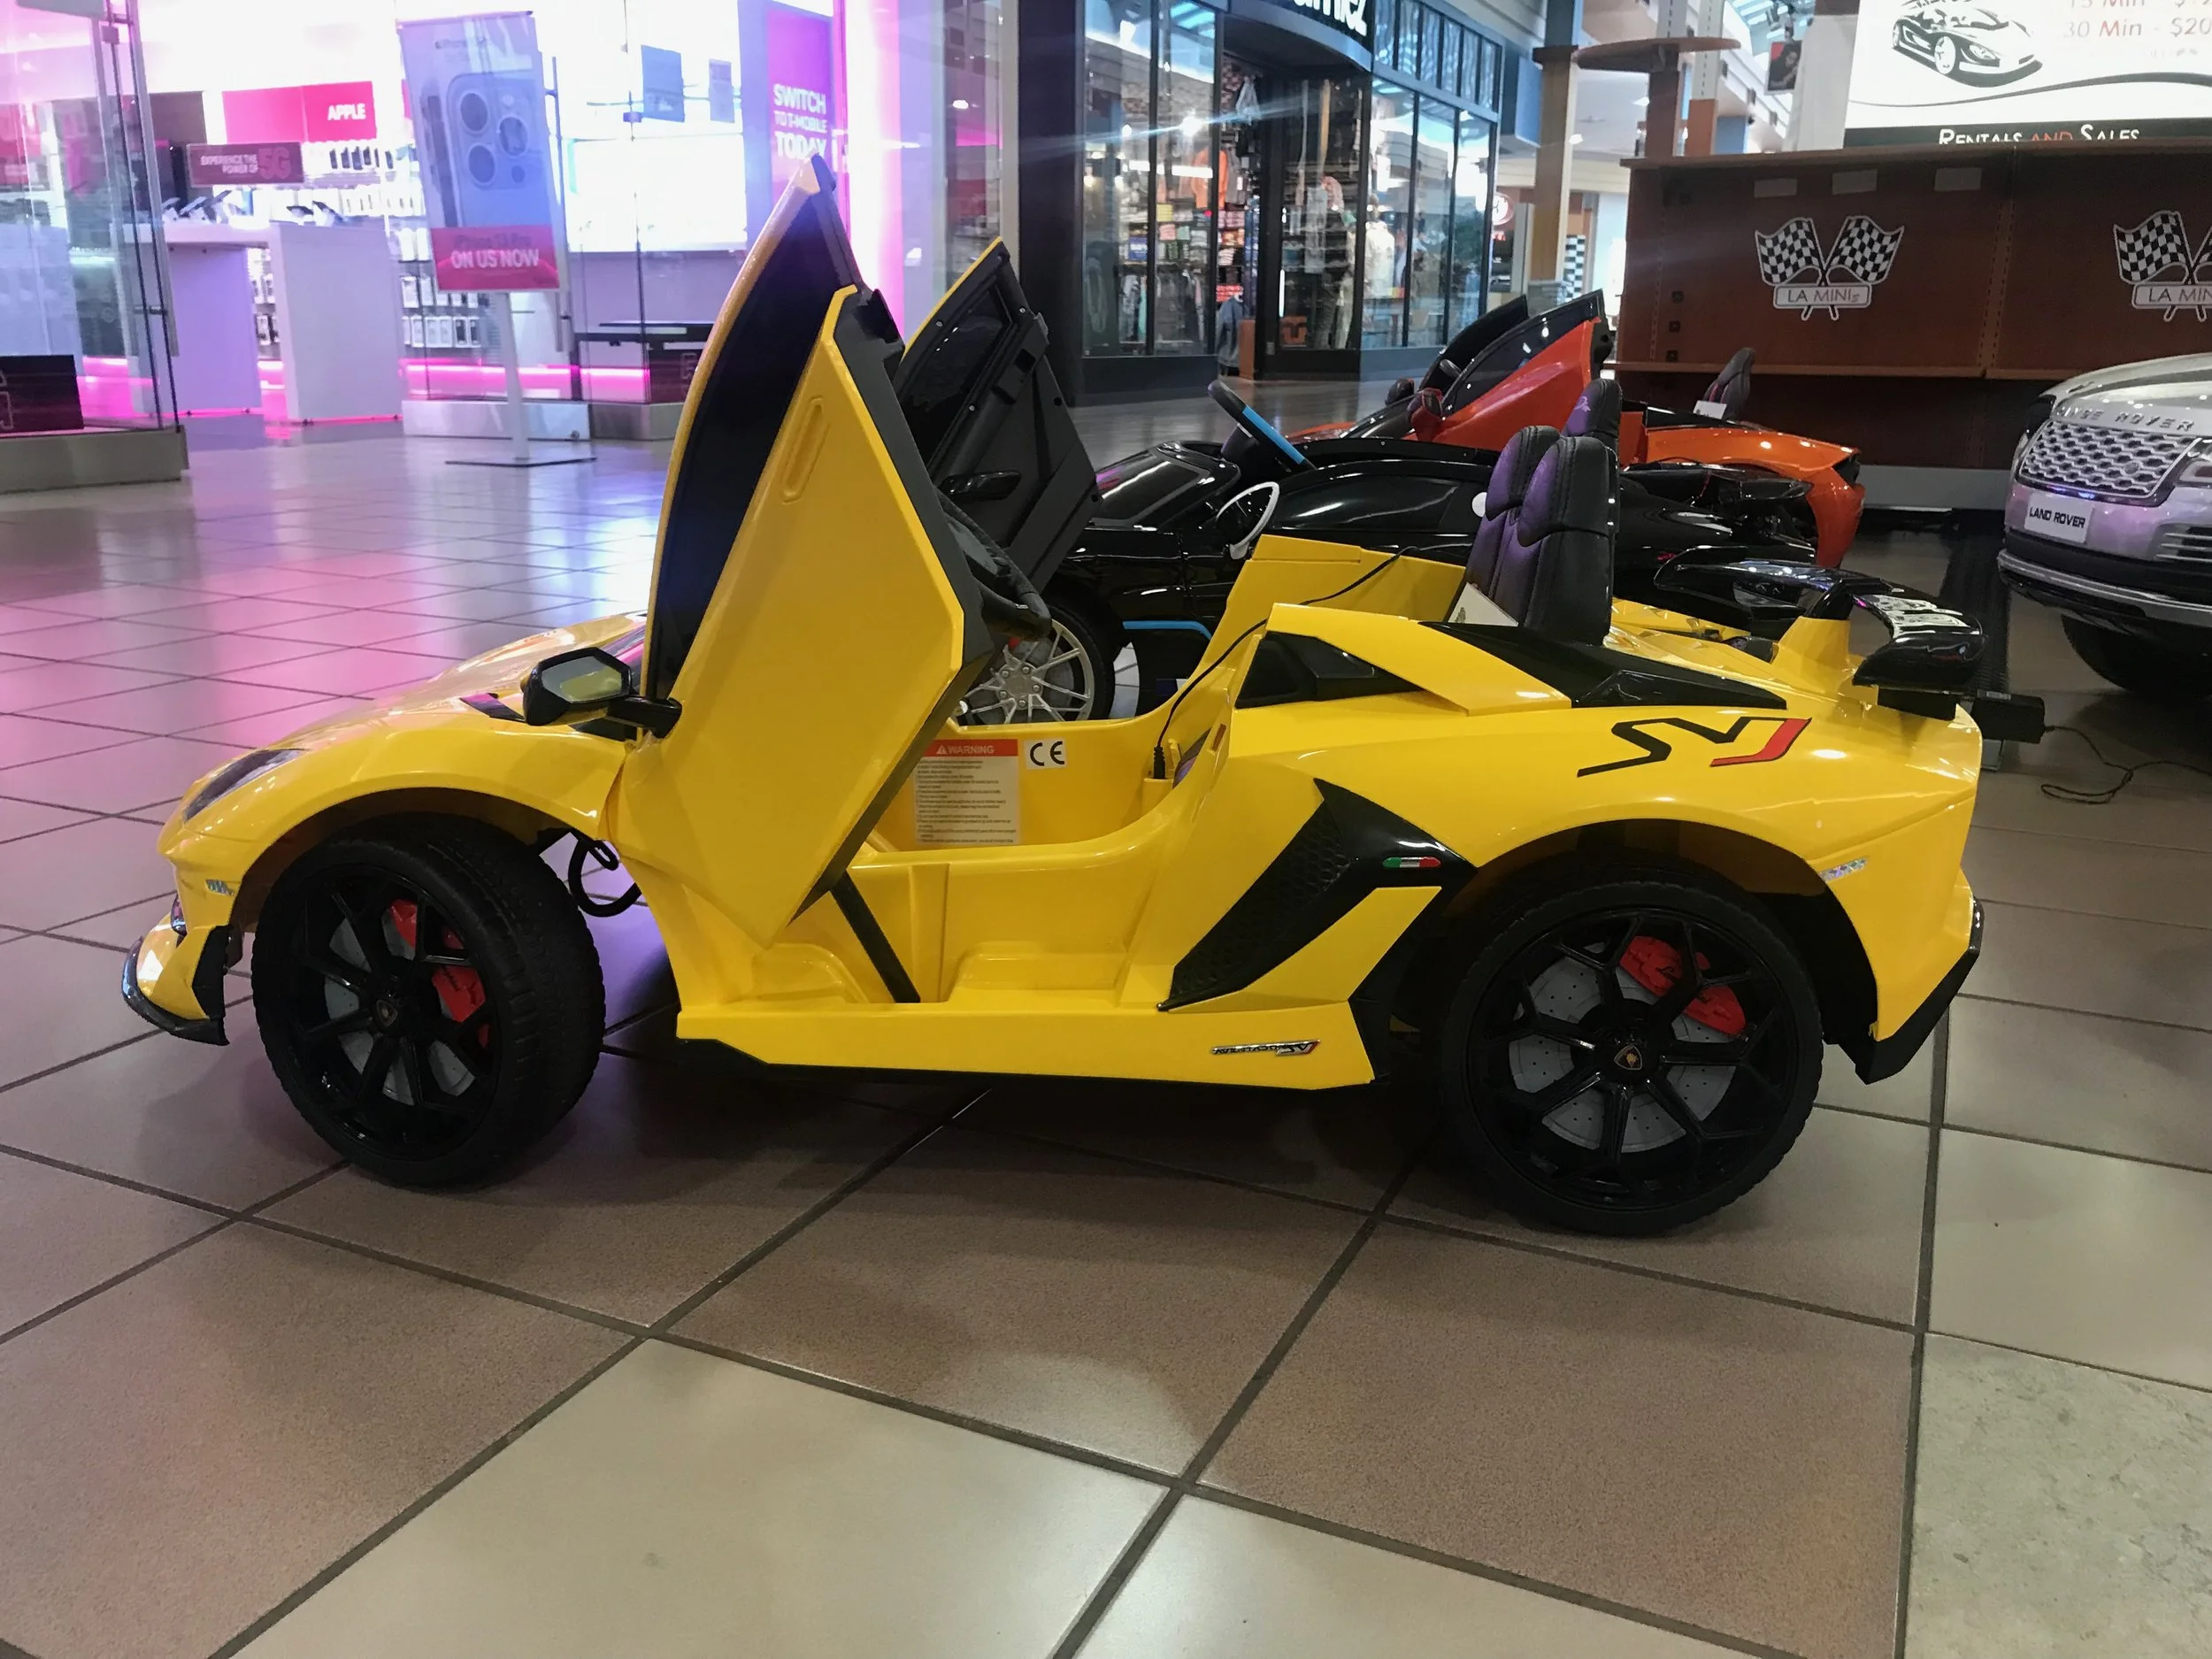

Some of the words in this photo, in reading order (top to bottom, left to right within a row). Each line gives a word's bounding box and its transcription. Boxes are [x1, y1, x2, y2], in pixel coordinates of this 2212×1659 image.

[2063, 20, 2090, 38] 30
[2099, 18, 2142, 37] Min
[2170, 17, 2212, 38] $20
[773, 84, 826, 115] SWITCH
[327, 103, 366, 121] APPLE
[773, 110, 787, 127] TO
[774, 131, 826, 159] TODAY
[258, 147, 291, 179] 5G
[449, 250, 475, 269] ON
[475, 250, 498, 267] US
[500, 248, 540, 267] NOW
[1787, 288, 1808, 303] LA
[2148, 287, 2171, 303] LA
[2029, 506, 2052, 521] LAND
[2054, 511, 2086, 529] ROVER
